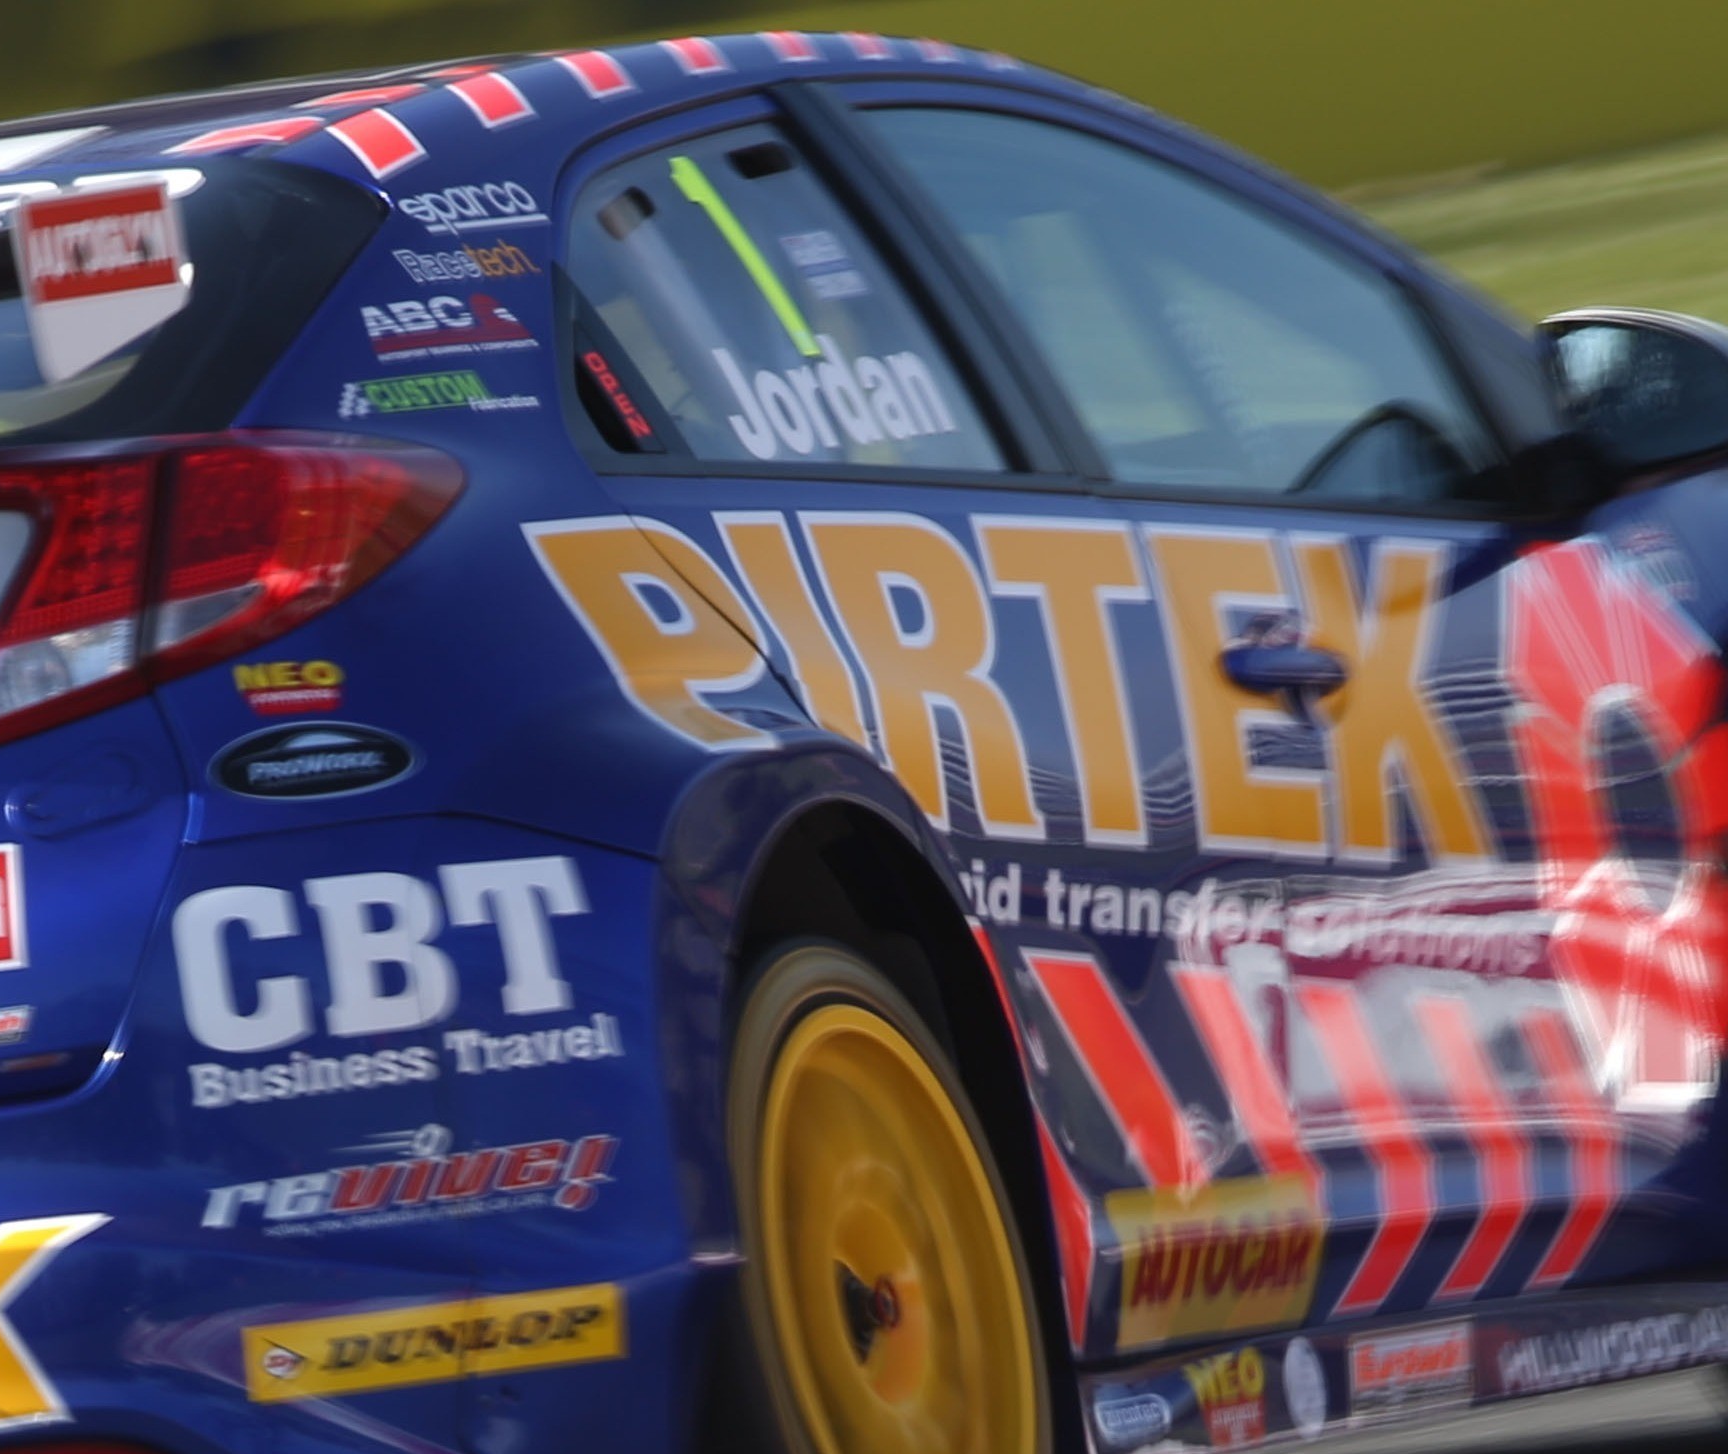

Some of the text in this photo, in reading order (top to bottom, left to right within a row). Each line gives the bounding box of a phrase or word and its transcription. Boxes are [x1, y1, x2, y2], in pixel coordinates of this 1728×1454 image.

[398, 181, 539, 237] sparco
[392, 238, 542, 284] Racetech
[360, 296, 474, 338] ABC
[363, 373, 488, 410] CUSTOM
[711, 333, 959, 460] Jordan
[234, 660, 343, 690] NEO
[520, 510, 1497, 869] PIRTEK
[171, 855, 591, 1053] CBT
[189, 1013, 624, 1108] Business Travel
[319, 1305, 605, 1371] DUNLOP
[1184, 1345, 1264, 1403] NEO
